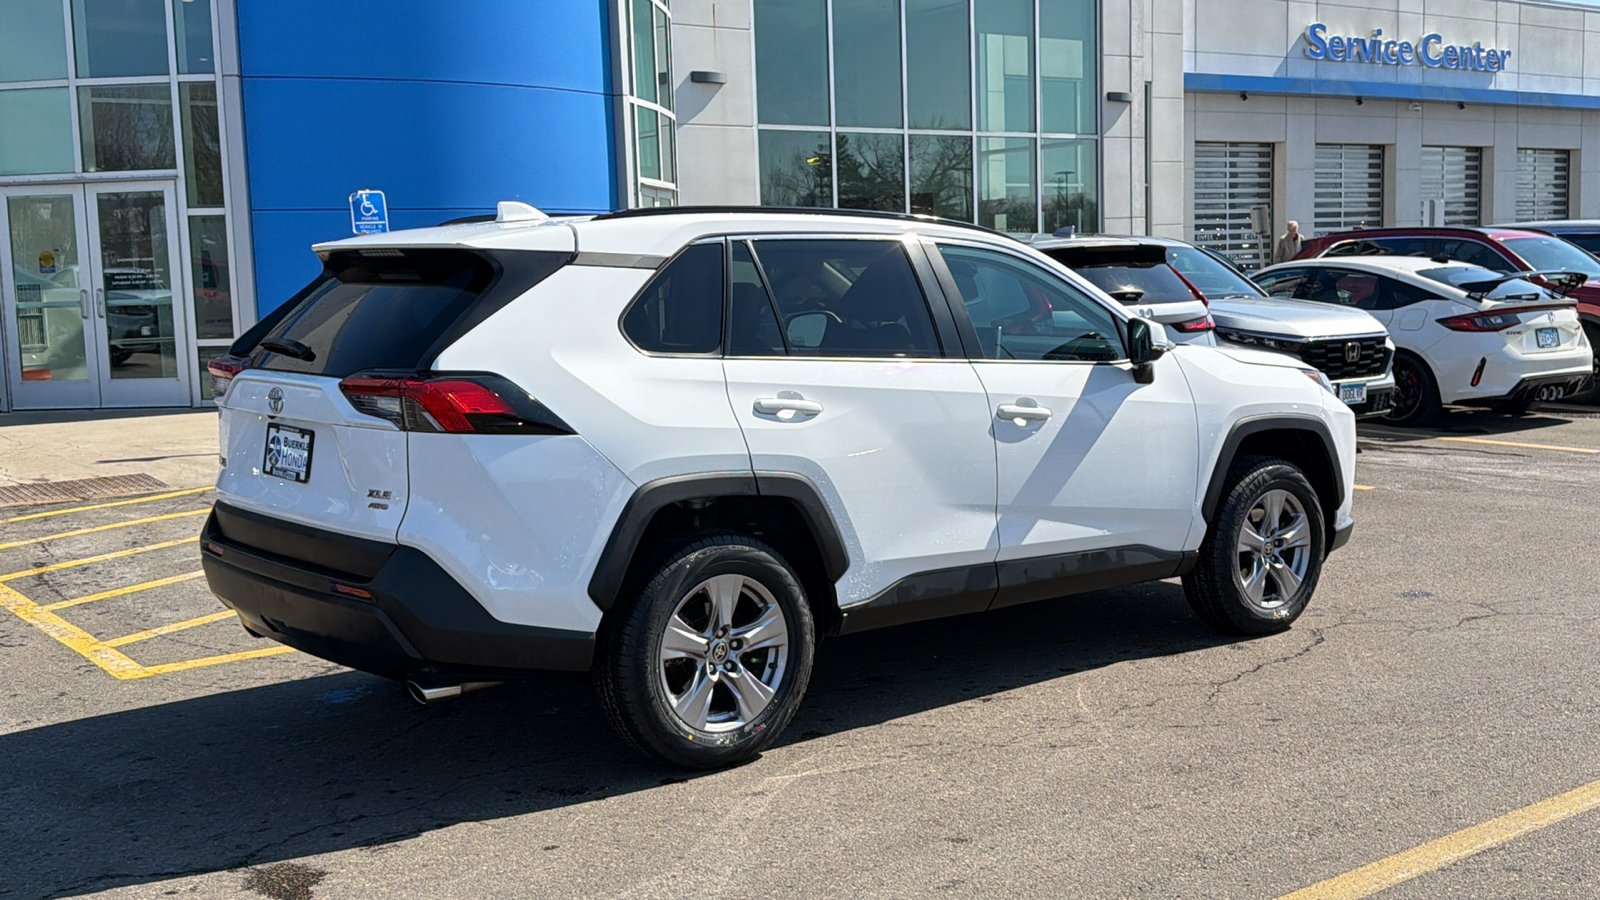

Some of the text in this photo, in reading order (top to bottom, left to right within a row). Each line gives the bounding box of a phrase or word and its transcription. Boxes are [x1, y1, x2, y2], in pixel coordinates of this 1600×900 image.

[1305, 22, 1511, 71] Service Center
[284, 436, 309, 451] BUERKLE
[281, 448, 308, 469] HONDA
[367, 489, 392, 500] XLE
[368, 502, 389, 510] AWD
